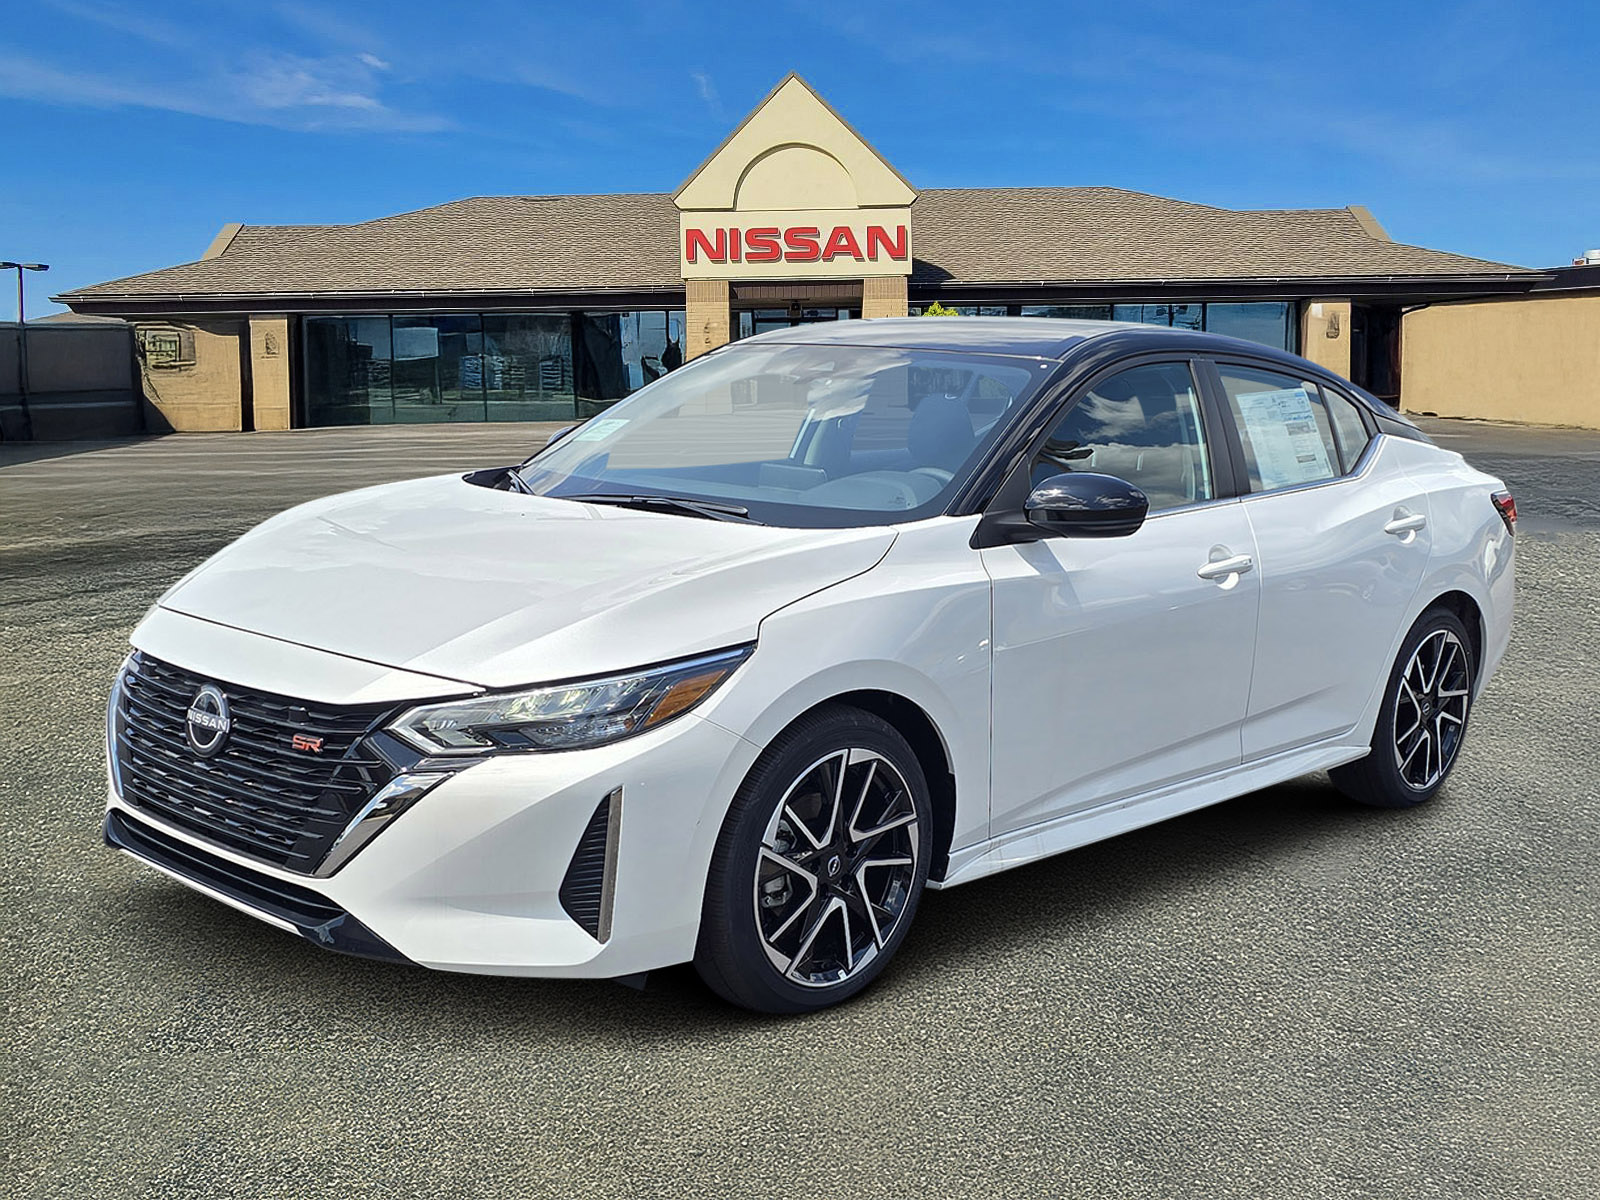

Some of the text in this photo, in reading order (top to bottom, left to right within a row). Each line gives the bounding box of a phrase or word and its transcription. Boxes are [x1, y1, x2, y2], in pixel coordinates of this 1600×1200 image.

[685, 225, 907, 263] NISSAN
[187, 709, 227, 731] NISSAN
[292, 735, 321, 753] SR
